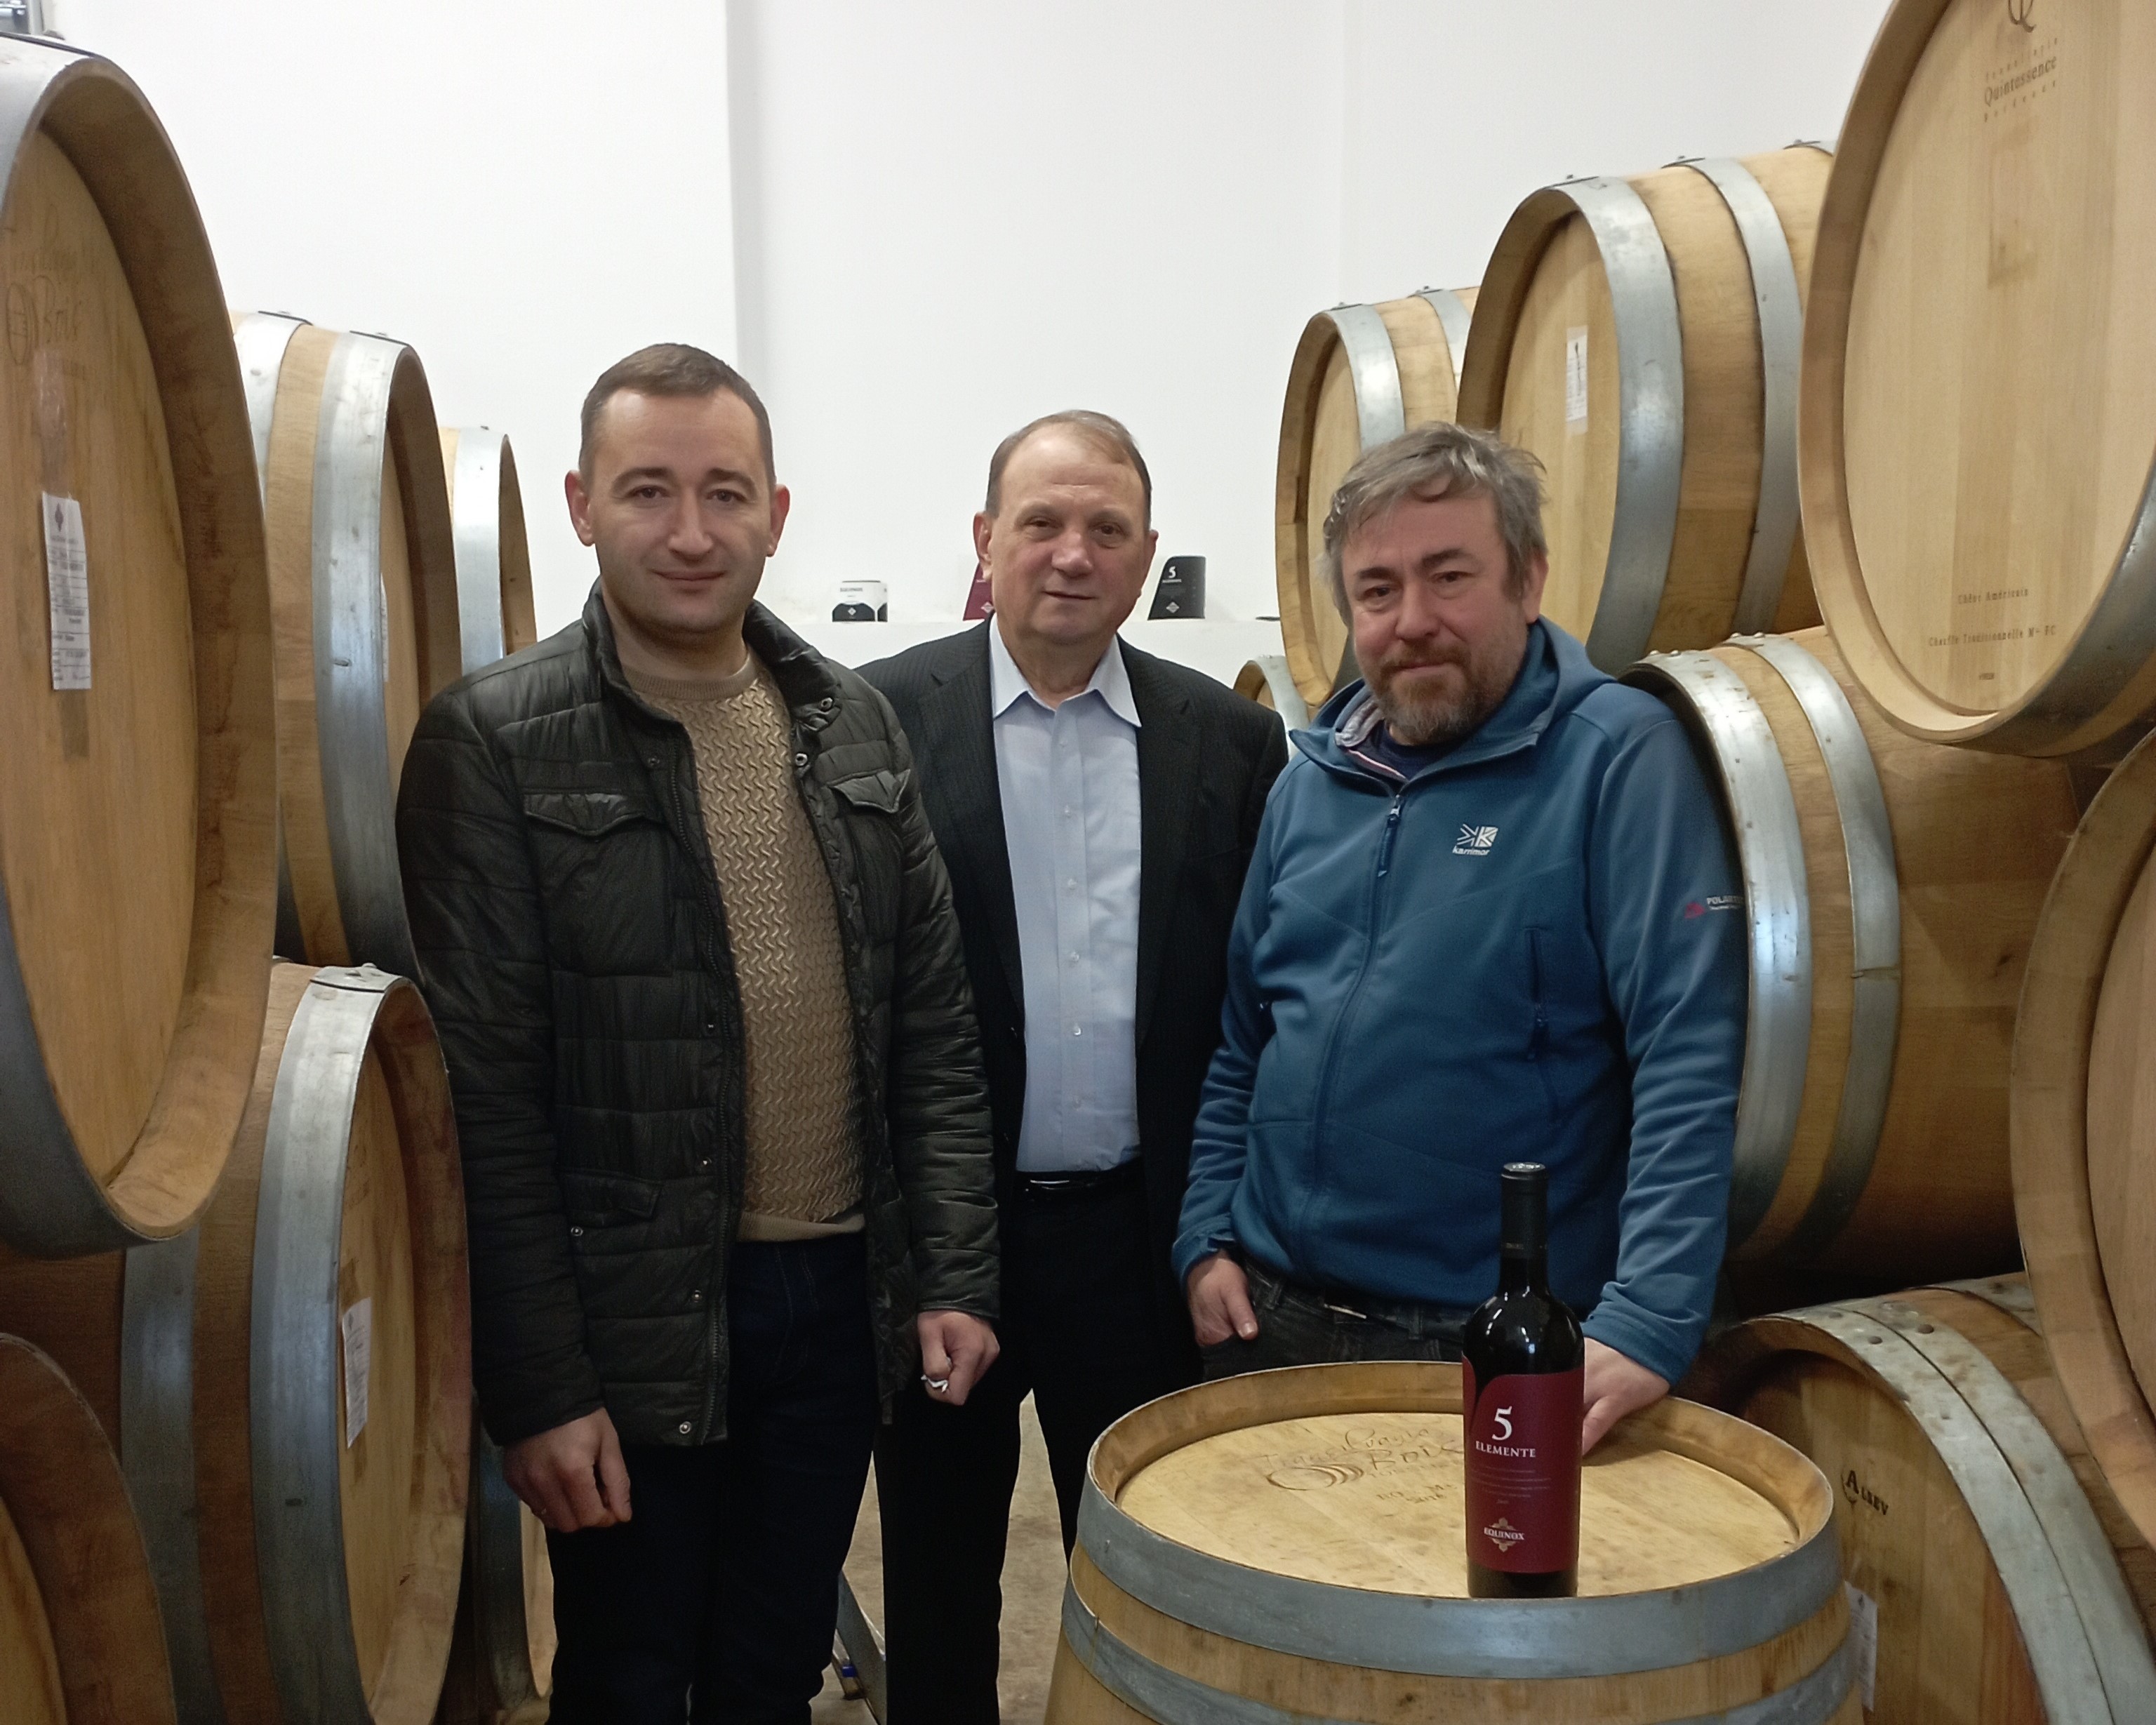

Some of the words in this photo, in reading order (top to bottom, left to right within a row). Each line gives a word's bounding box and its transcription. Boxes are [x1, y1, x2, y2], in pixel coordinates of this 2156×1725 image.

[1984, 56, 2057, 107] Quintessence
[1491, 1406, 1512, 1441] 5
[1475, 1440, 1536, 1458] ELEMENTE
[1483, 1526, 1525, 1540] EQUINOX
